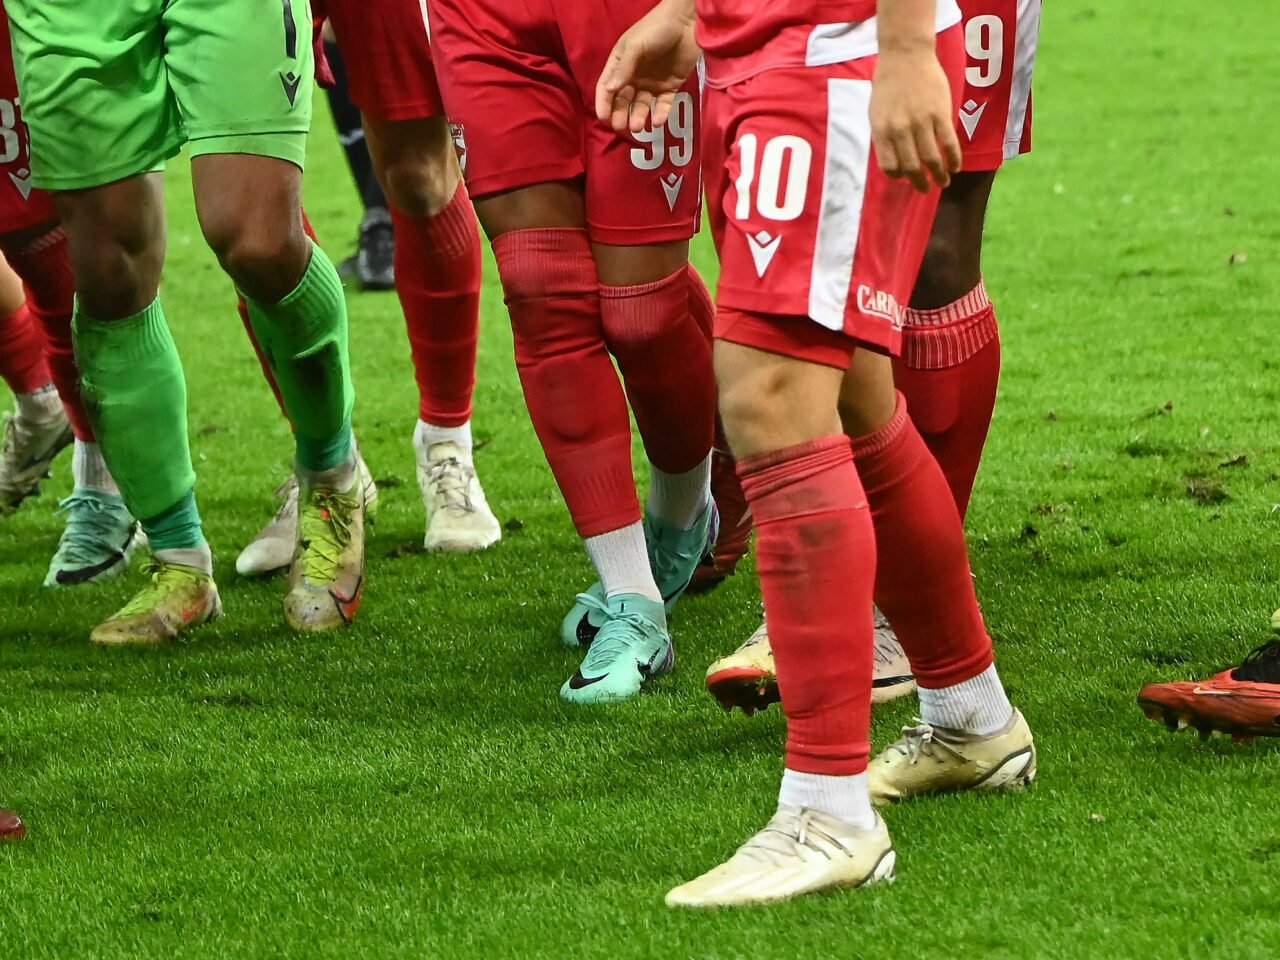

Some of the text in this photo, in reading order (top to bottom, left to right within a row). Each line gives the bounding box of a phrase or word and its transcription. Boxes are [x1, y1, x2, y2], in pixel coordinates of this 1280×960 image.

[965, 14, 1004, 88] 9
[630, 92, 694, 171] 99
[735, 133, 813, 221] 10
